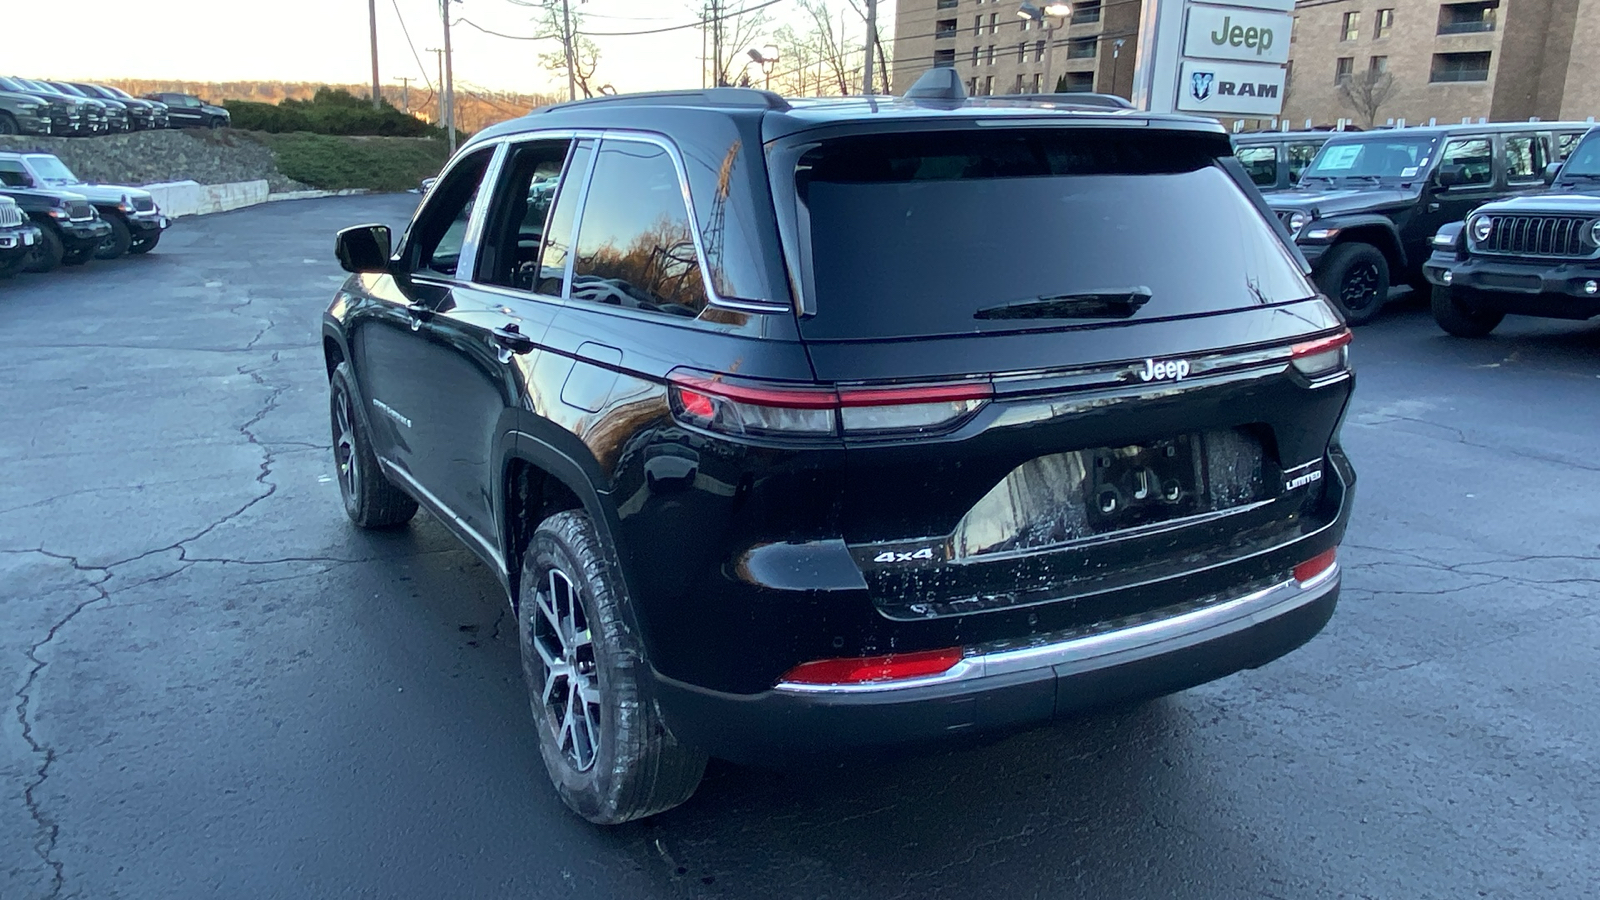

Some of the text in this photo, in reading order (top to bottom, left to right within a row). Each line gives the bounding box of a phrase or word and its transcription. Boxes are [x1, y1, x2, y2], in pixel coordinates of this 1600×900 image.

[1211, 16, 1273, 55] Jeep
[1218, 81, 1278, 98] RAM
[1140, 358, 1190, 381] Jeep
